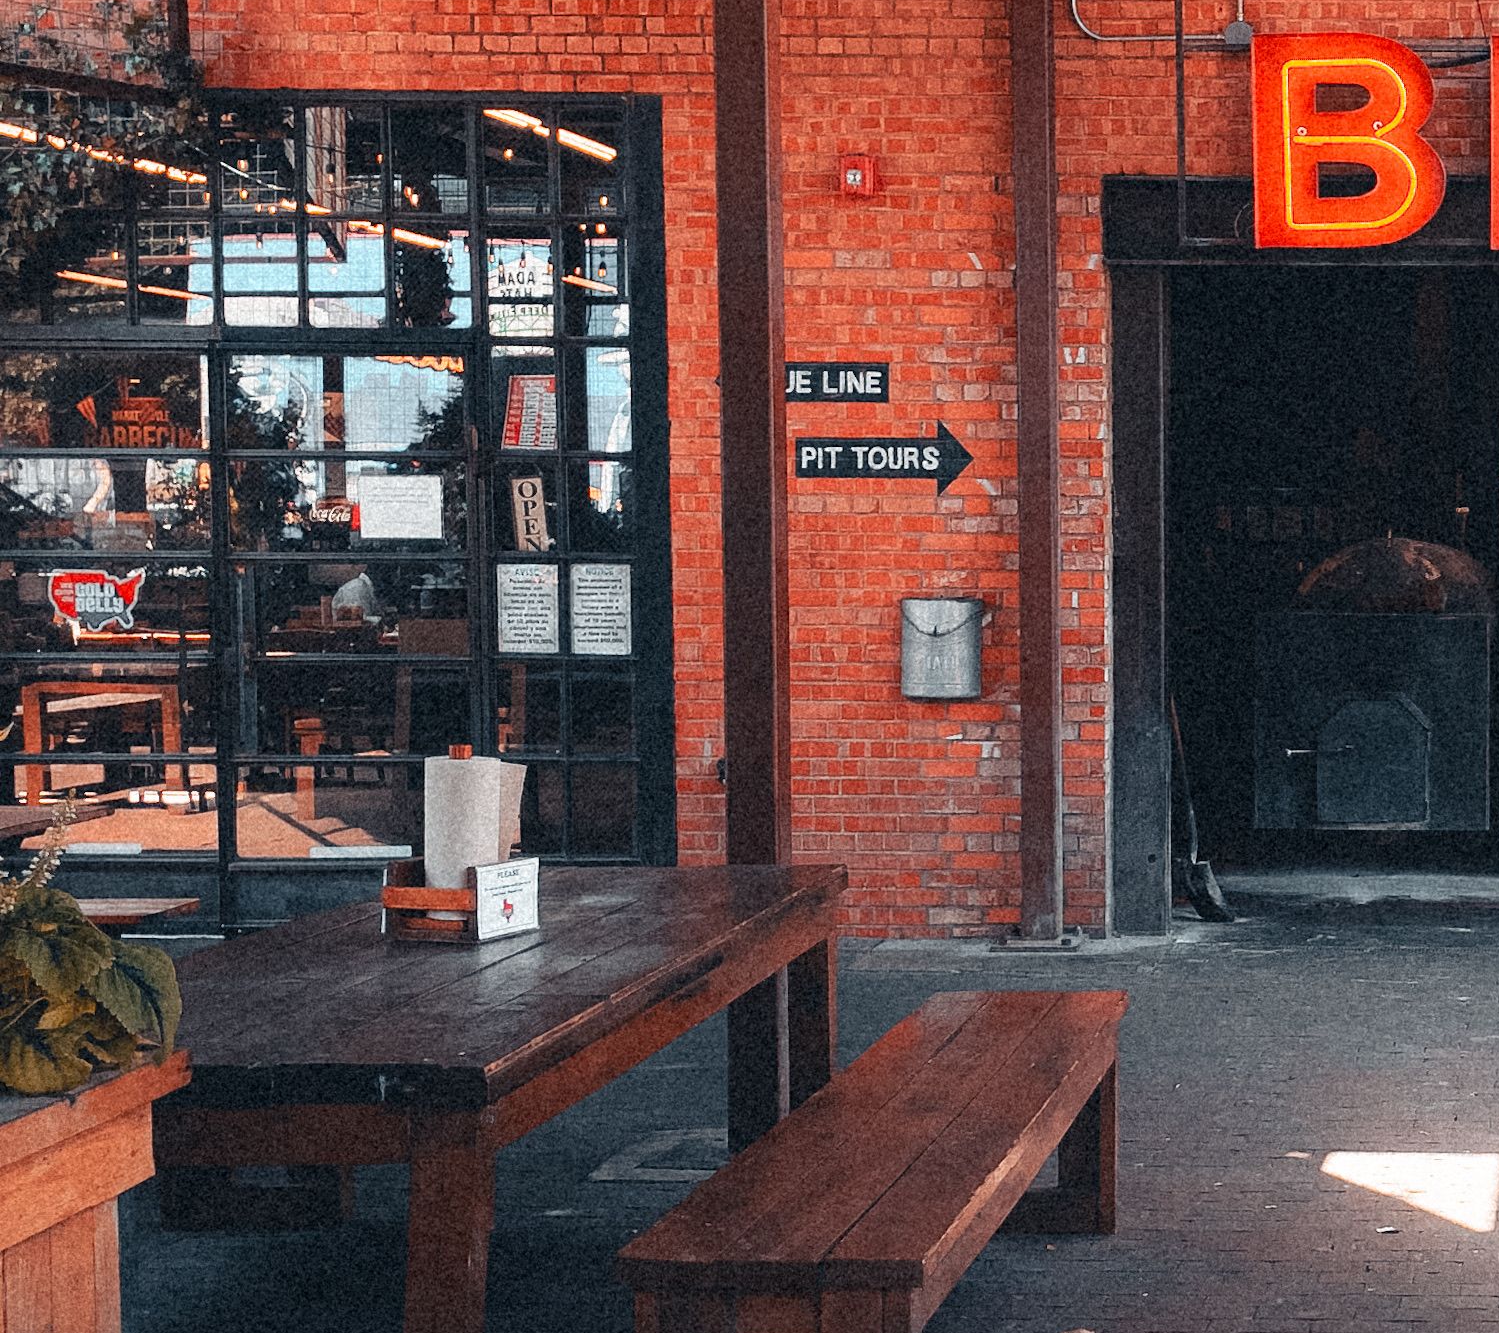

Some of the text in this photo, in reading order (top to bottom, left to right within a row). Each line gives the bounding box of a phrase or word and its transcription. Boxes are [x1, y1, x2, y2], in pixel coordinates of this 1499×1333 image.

[822, 370, 882, 394] LINE
[801, 446, 940, 471] PIT TOURS
[517, 480, 542, 552] OPEN
